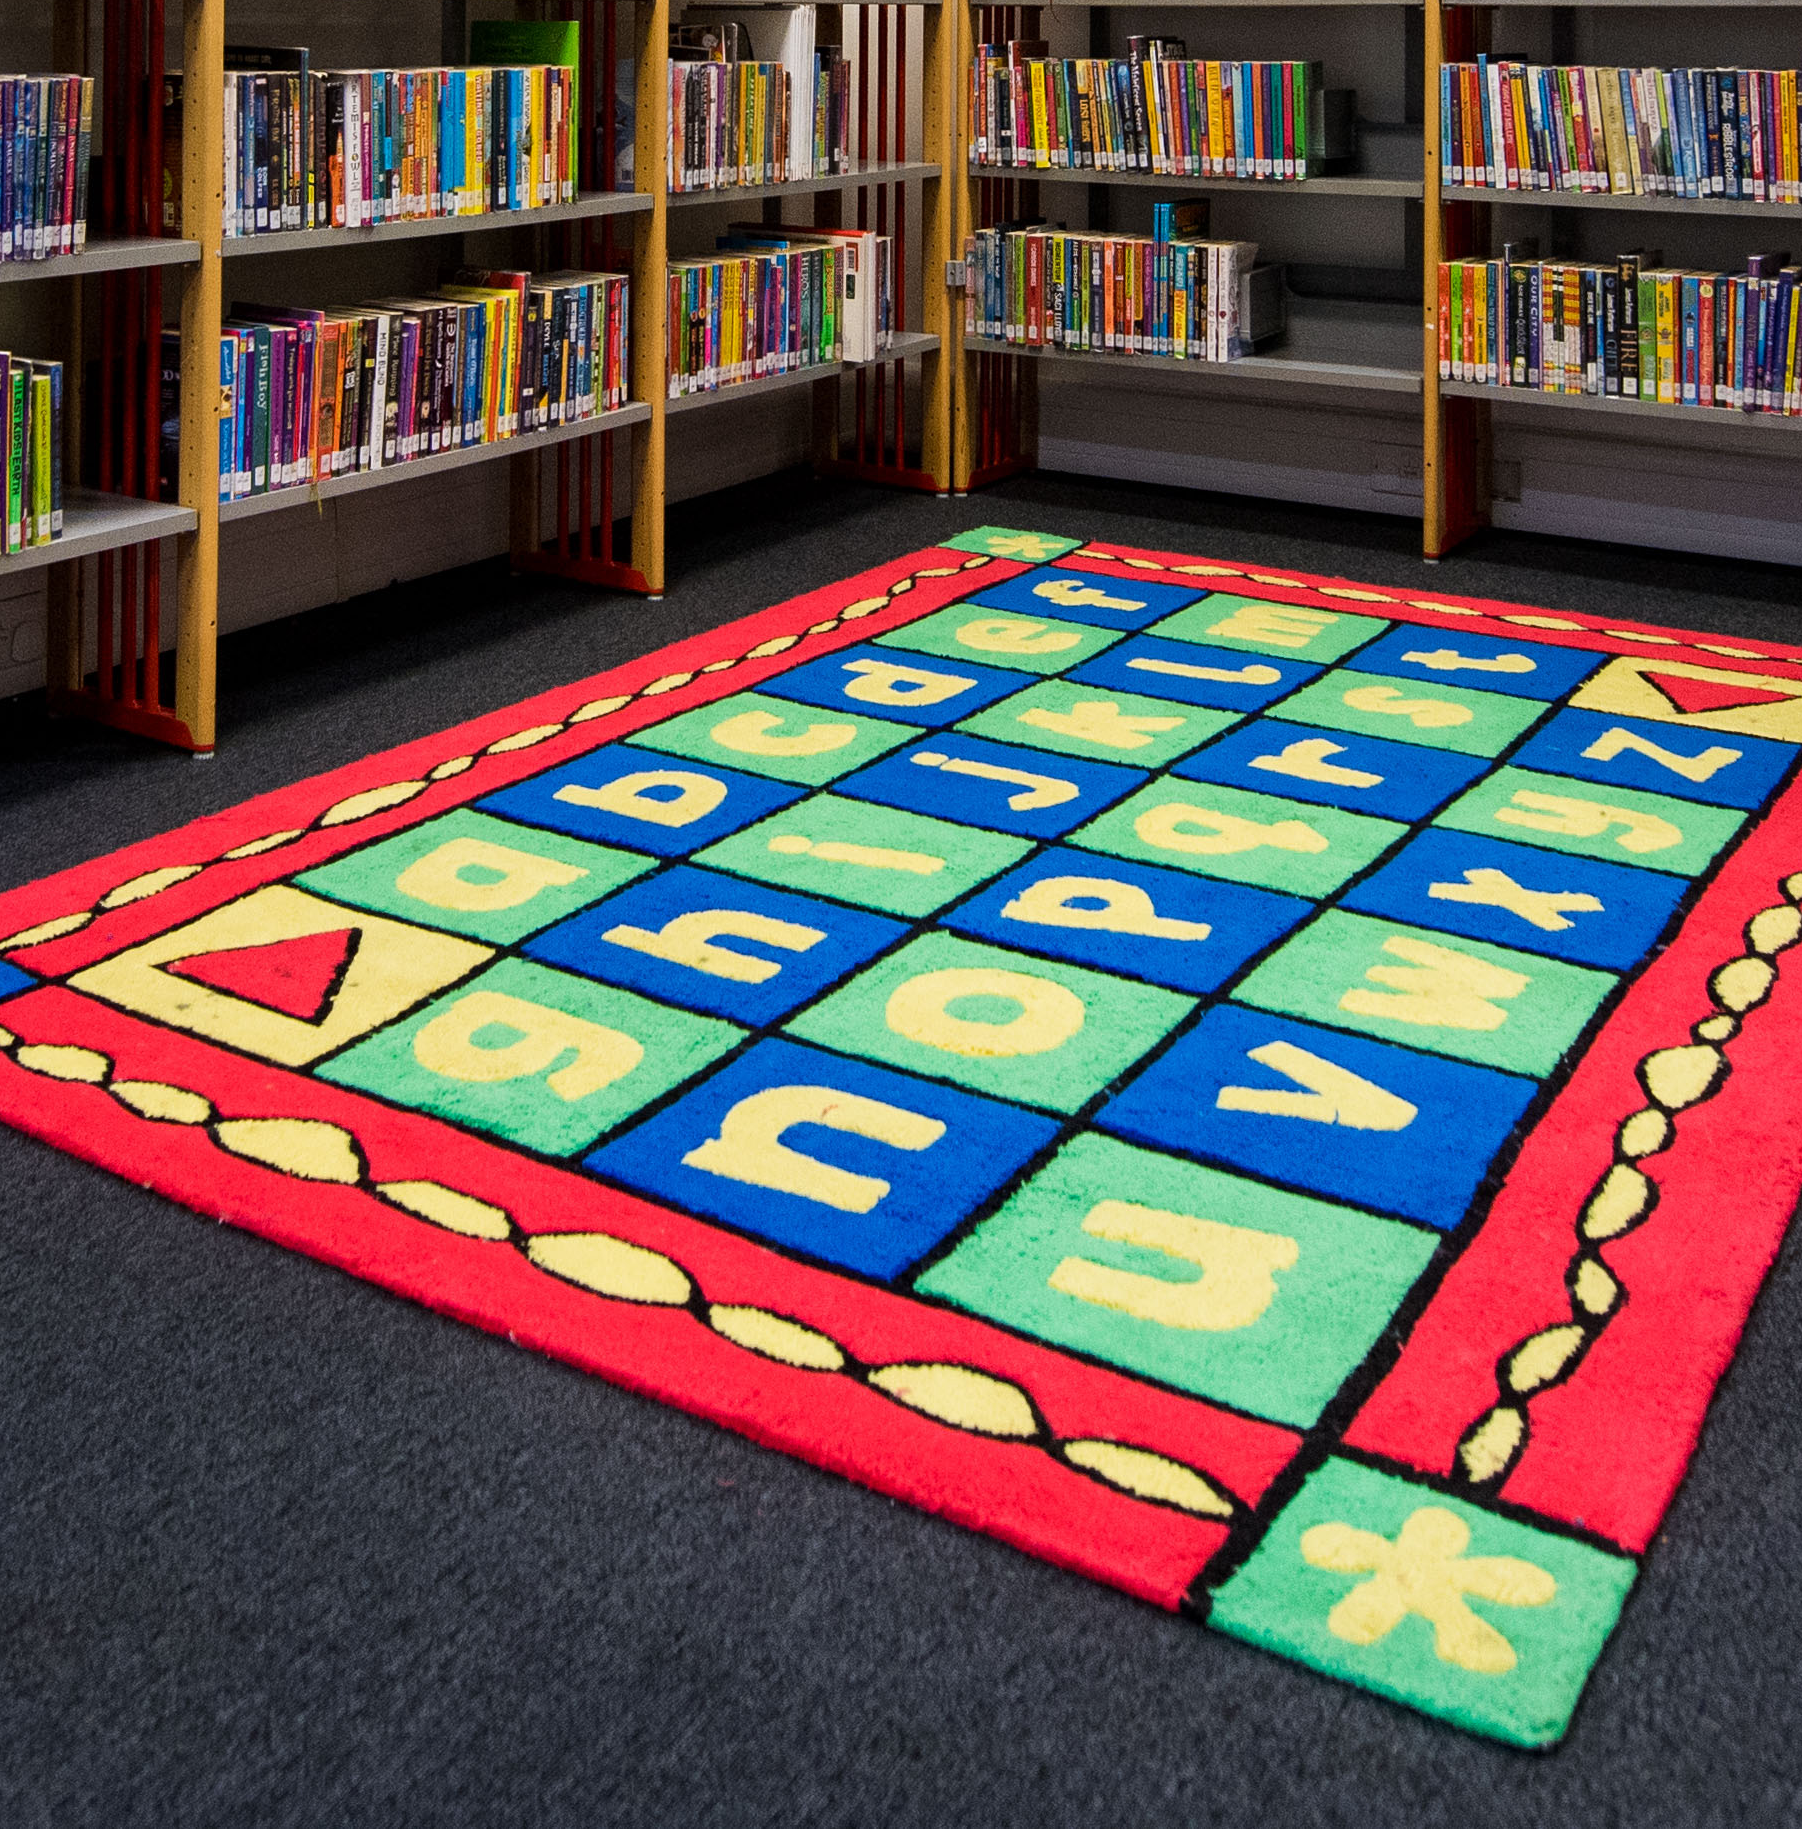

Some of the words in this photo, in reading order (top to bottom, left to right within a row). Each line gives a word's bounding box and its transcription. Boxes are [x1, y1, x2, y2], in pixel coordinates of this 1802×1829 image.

[378, 332, 387, 358] MIND
[378, 361, 387, 386] BLIND
[1021, 702, 1182, 747] k
[1252, 740, 1380, 786] r
[398, 839, 586, 909] a
[1340, 937, 1527, 1028] w
[886, 969, 1083, 1055] o
